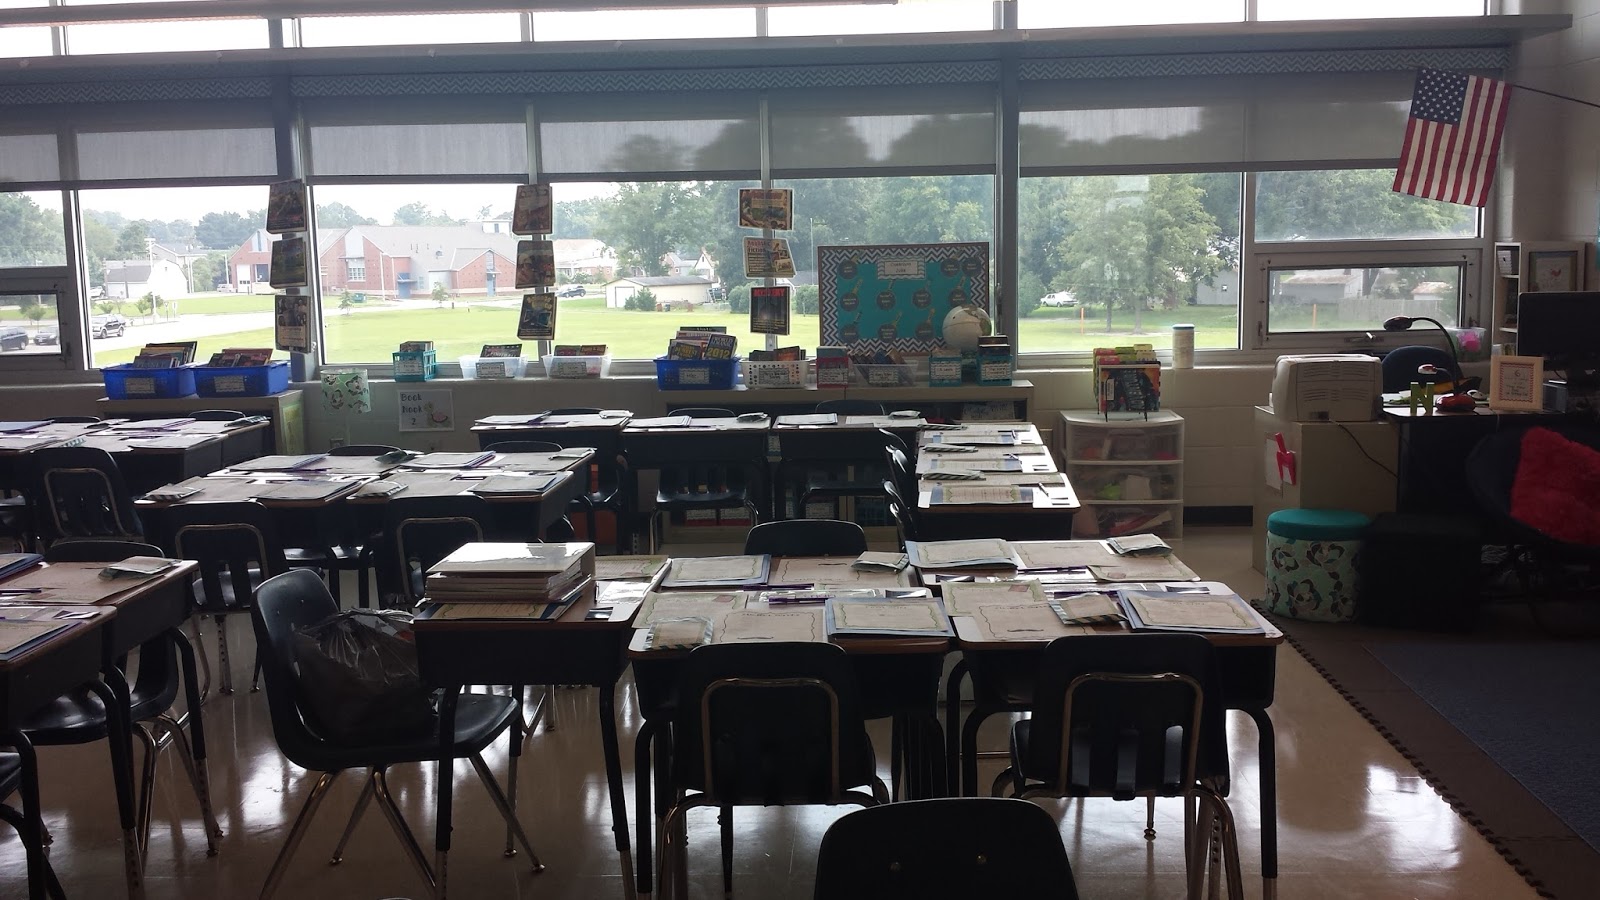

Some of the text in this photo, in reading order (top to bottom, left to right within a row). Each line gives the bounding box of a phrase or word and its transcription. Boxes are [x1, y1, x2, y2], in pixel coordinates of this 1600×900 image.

[707, 347, 730, 359] 2012
[401, 393, 422, 401] Book
[1410, 381, 1435, 416] N
[401, 405, 423, 413] Nook
[411, 417, 417, 425] 2
